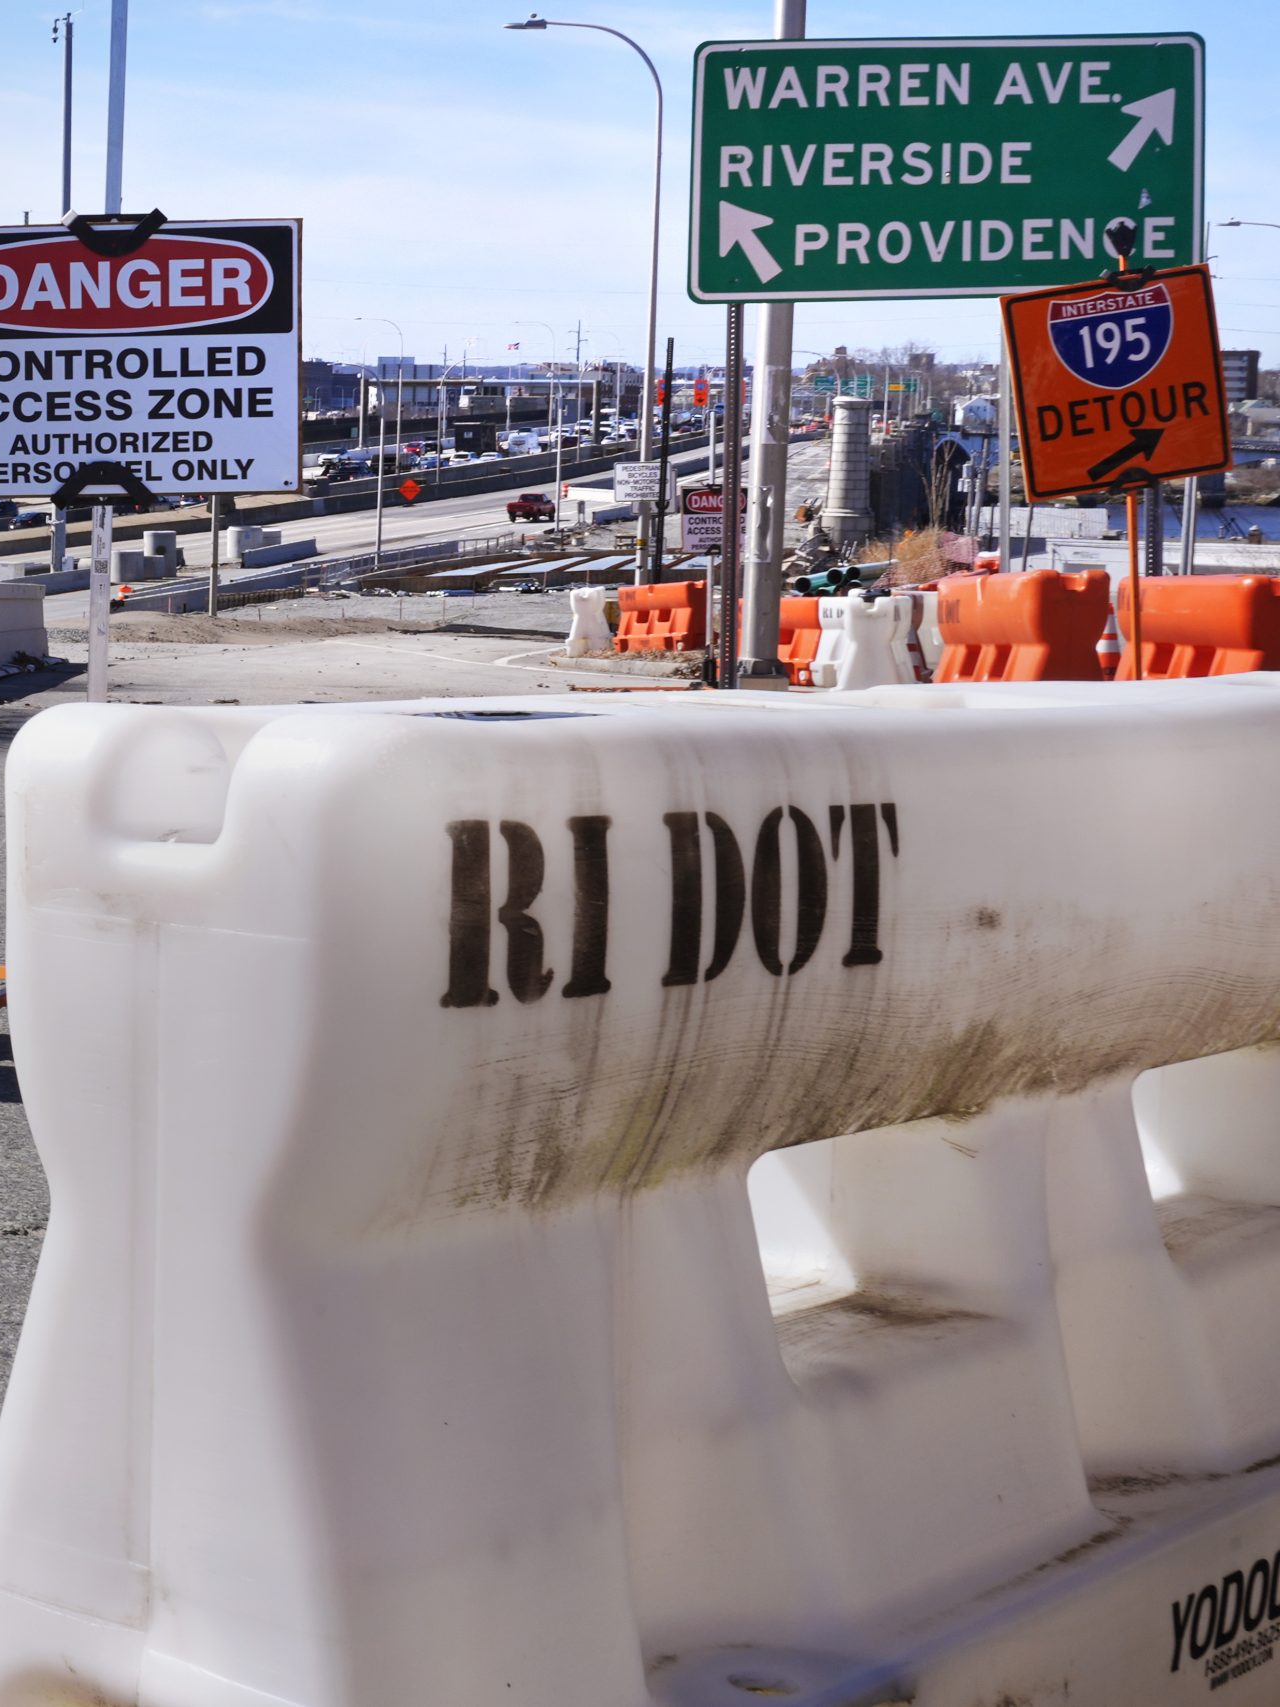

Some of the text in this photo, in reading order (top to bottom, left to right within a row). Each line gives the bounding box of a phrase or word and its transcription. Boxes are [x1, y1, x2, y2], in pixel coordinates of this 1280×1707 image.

[723, 61, 1123, 110] WARREN AVE.
[719, 142, 1032, 188] RIVERSIDE
[794, 216, 1175, 266] PROVIDENCE
[1062, 292, 1154, 318] INTERSTATE
[1079, 317, 1151, 368] 195
[147, 387, 274, 420] ZONE
[1037, 381, 1210, 442] DETOUR
[9, 431, 213, 456] AUTHORIZED
[172, 458, 255, 481] ONLY
[691, 495, 724, 508] DANG
[687, 526, 722, 535] ACCESS
[439, 802, 900, 1009] RI DOT
